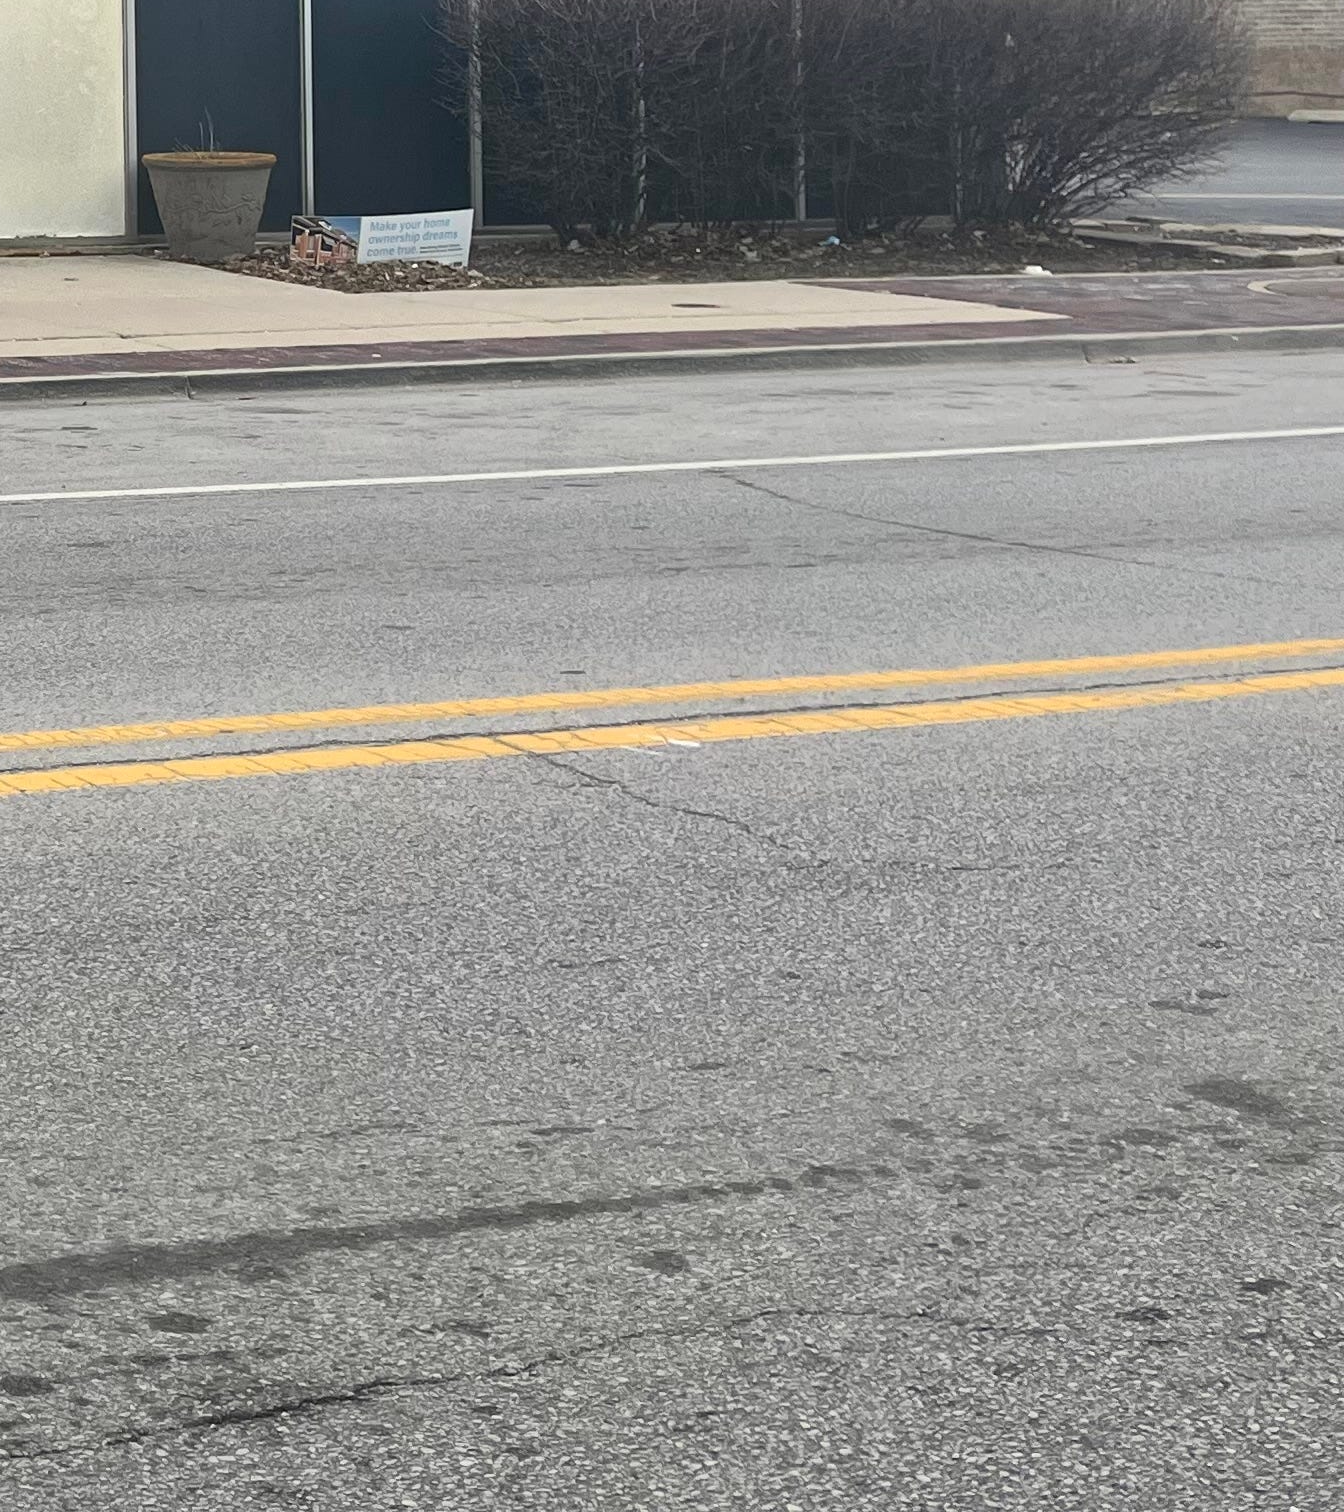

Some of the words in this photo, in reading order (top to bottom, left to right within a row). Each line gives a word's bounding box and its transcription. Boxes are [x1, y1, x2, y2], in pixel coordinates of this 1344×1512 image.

[370, 221, 397, 232] Make
[399, 221, 420, 232] your
[423, 218, 450, 228] home
[368, 231, 420, 244] ownership
[422, 231, 458, 241] dreams
[367, 248, 395, 257] come
